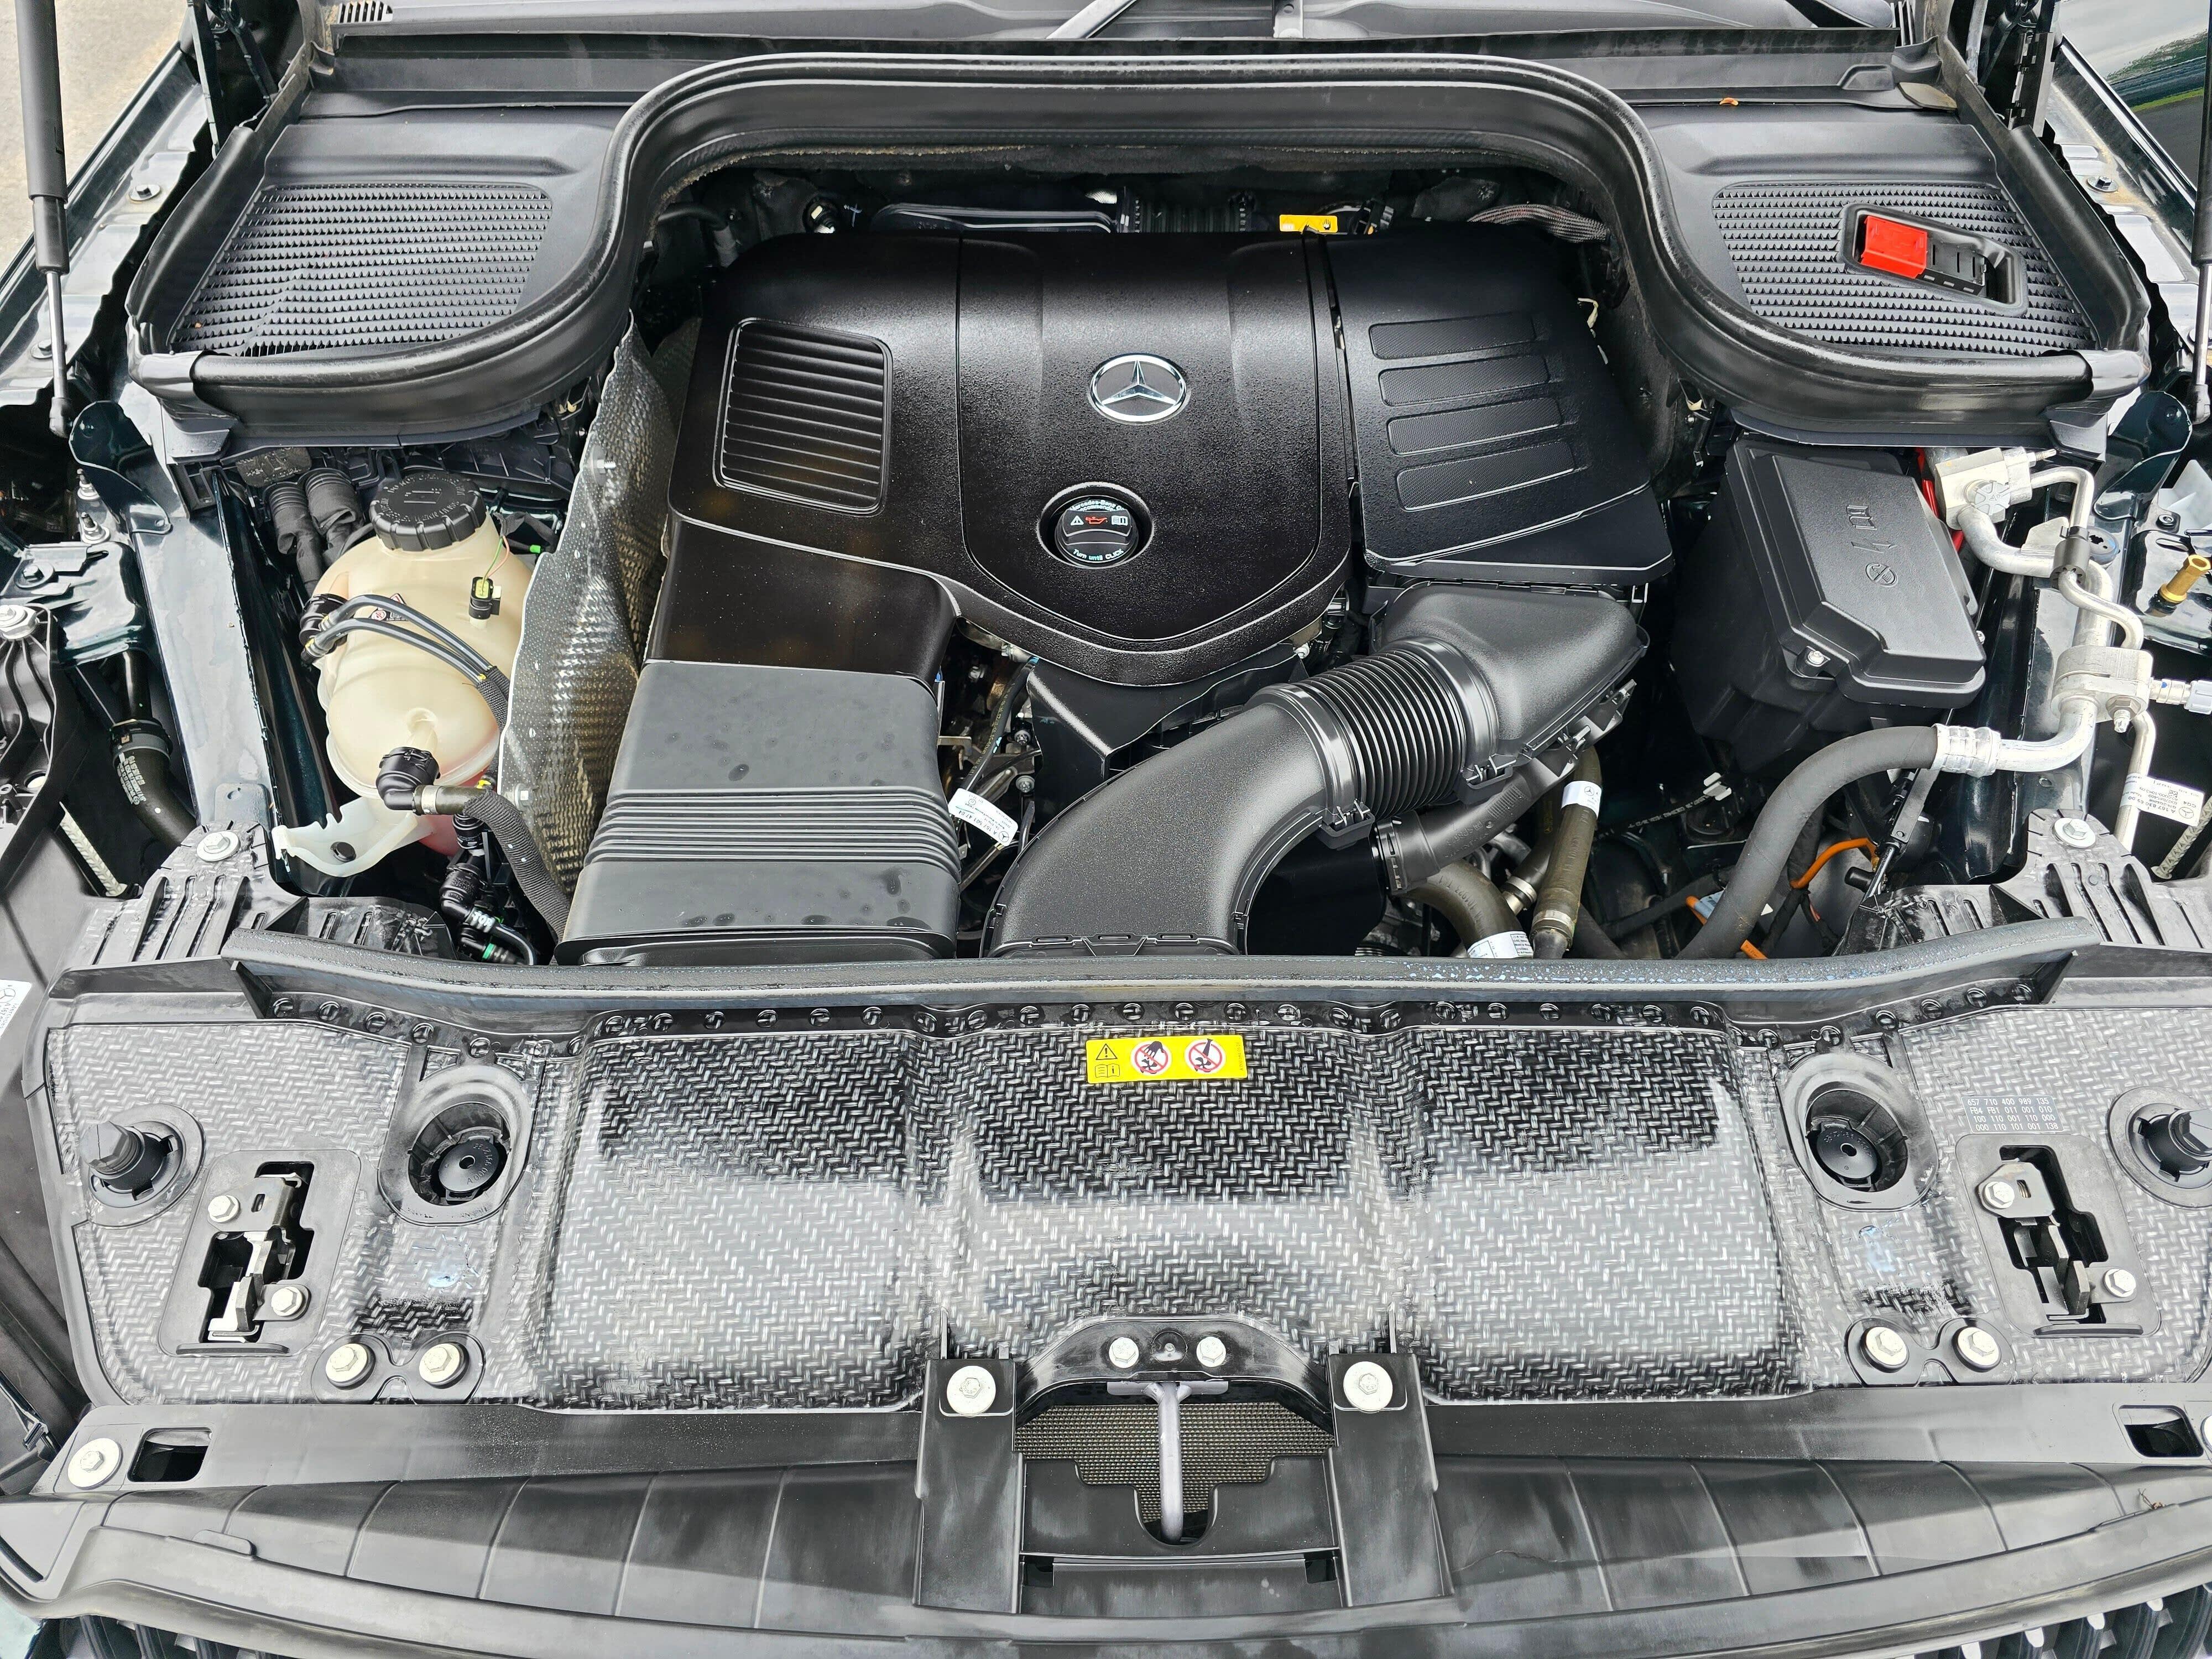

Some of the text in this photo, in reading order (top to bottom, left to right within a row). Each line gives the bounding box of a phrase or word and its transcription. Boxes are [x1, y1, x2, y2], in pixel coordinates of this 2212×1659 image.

[1073, 549, 1087, 559] Turn
[1105, 549, 1124, 559] CLICK
[474, 1167, 488, 1181] 000
